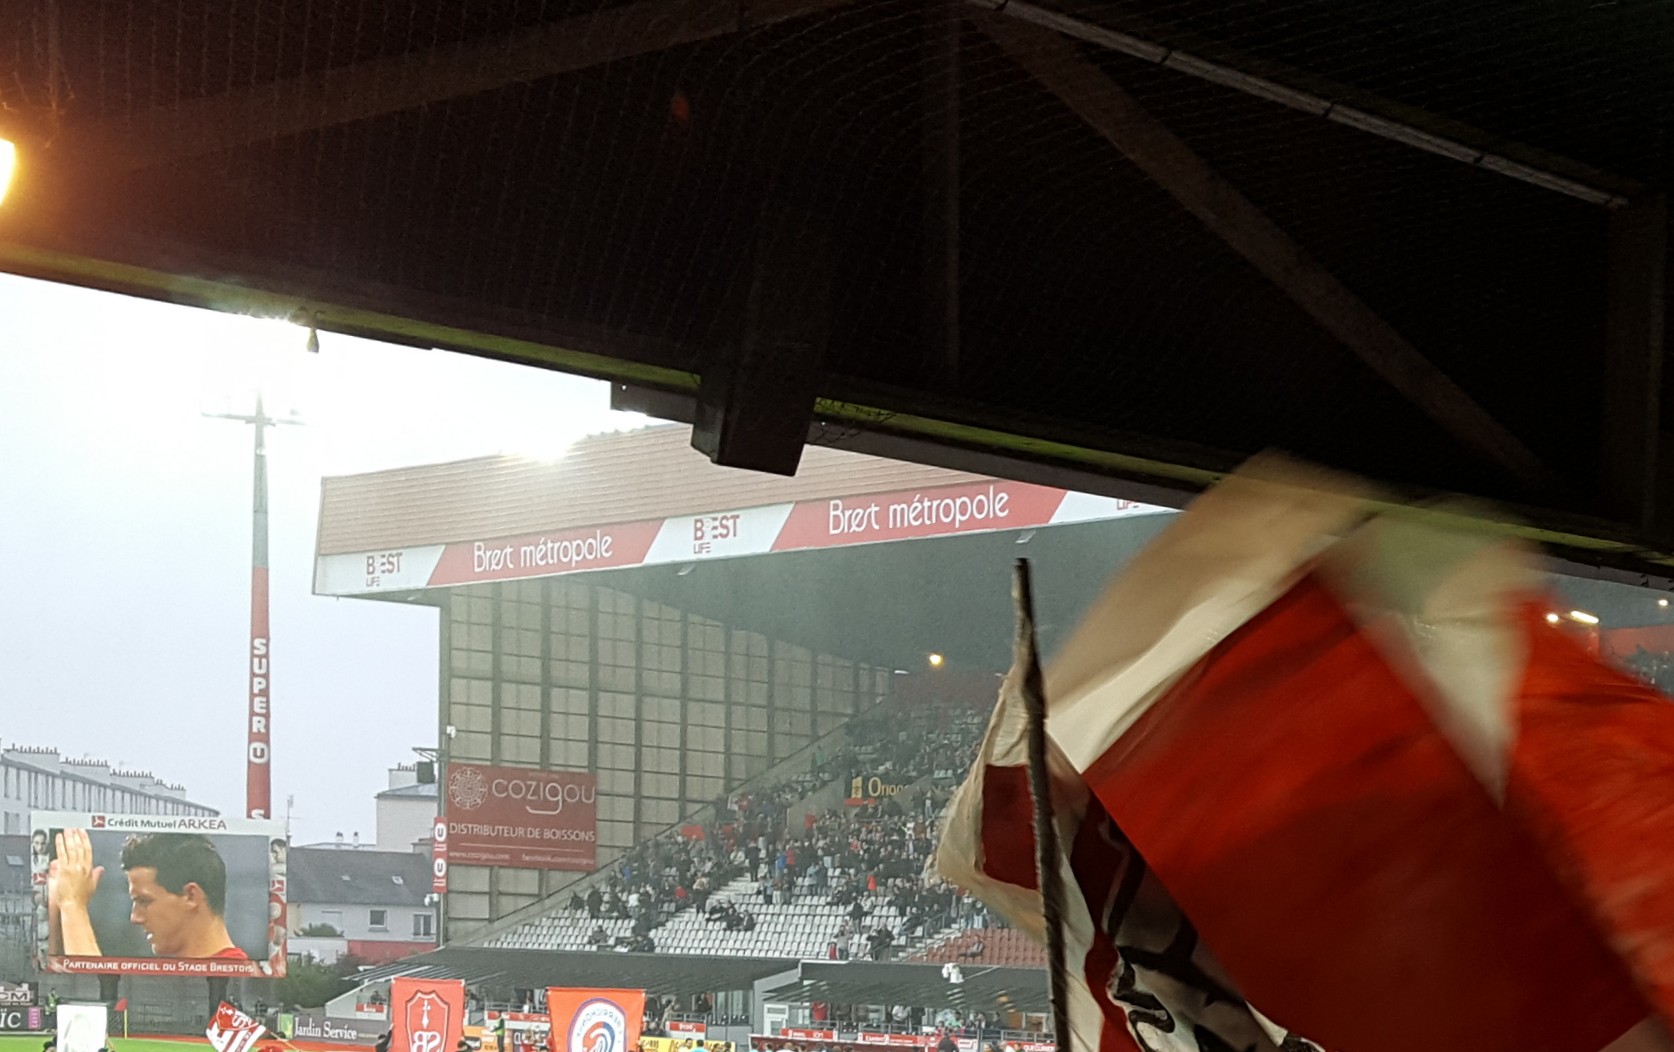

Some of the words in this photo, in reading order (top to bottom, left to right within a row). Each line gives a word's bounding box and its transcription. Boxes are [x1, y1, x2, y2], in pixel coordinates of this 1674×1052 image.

[829, 499, 881, 535] Brest
[888, 484, 1010, 527] métropole
[473, 541, 514, 573] Brest
[520, 529, 613, 568] métropole
[252, 637, 267, 733] SUPER
[140, 819, 176, 829] Mutuel
[177, 819, 227, 830] ARKEA
[449, 822, 525, 838] DISTRIBUTEUR
[527, 827, 541, 839] DE
[543, 828, 595, 842] BOISSONS
[294, 1016, 321, 1037] Jardin
[324, 1023, 358, 1040] Service
